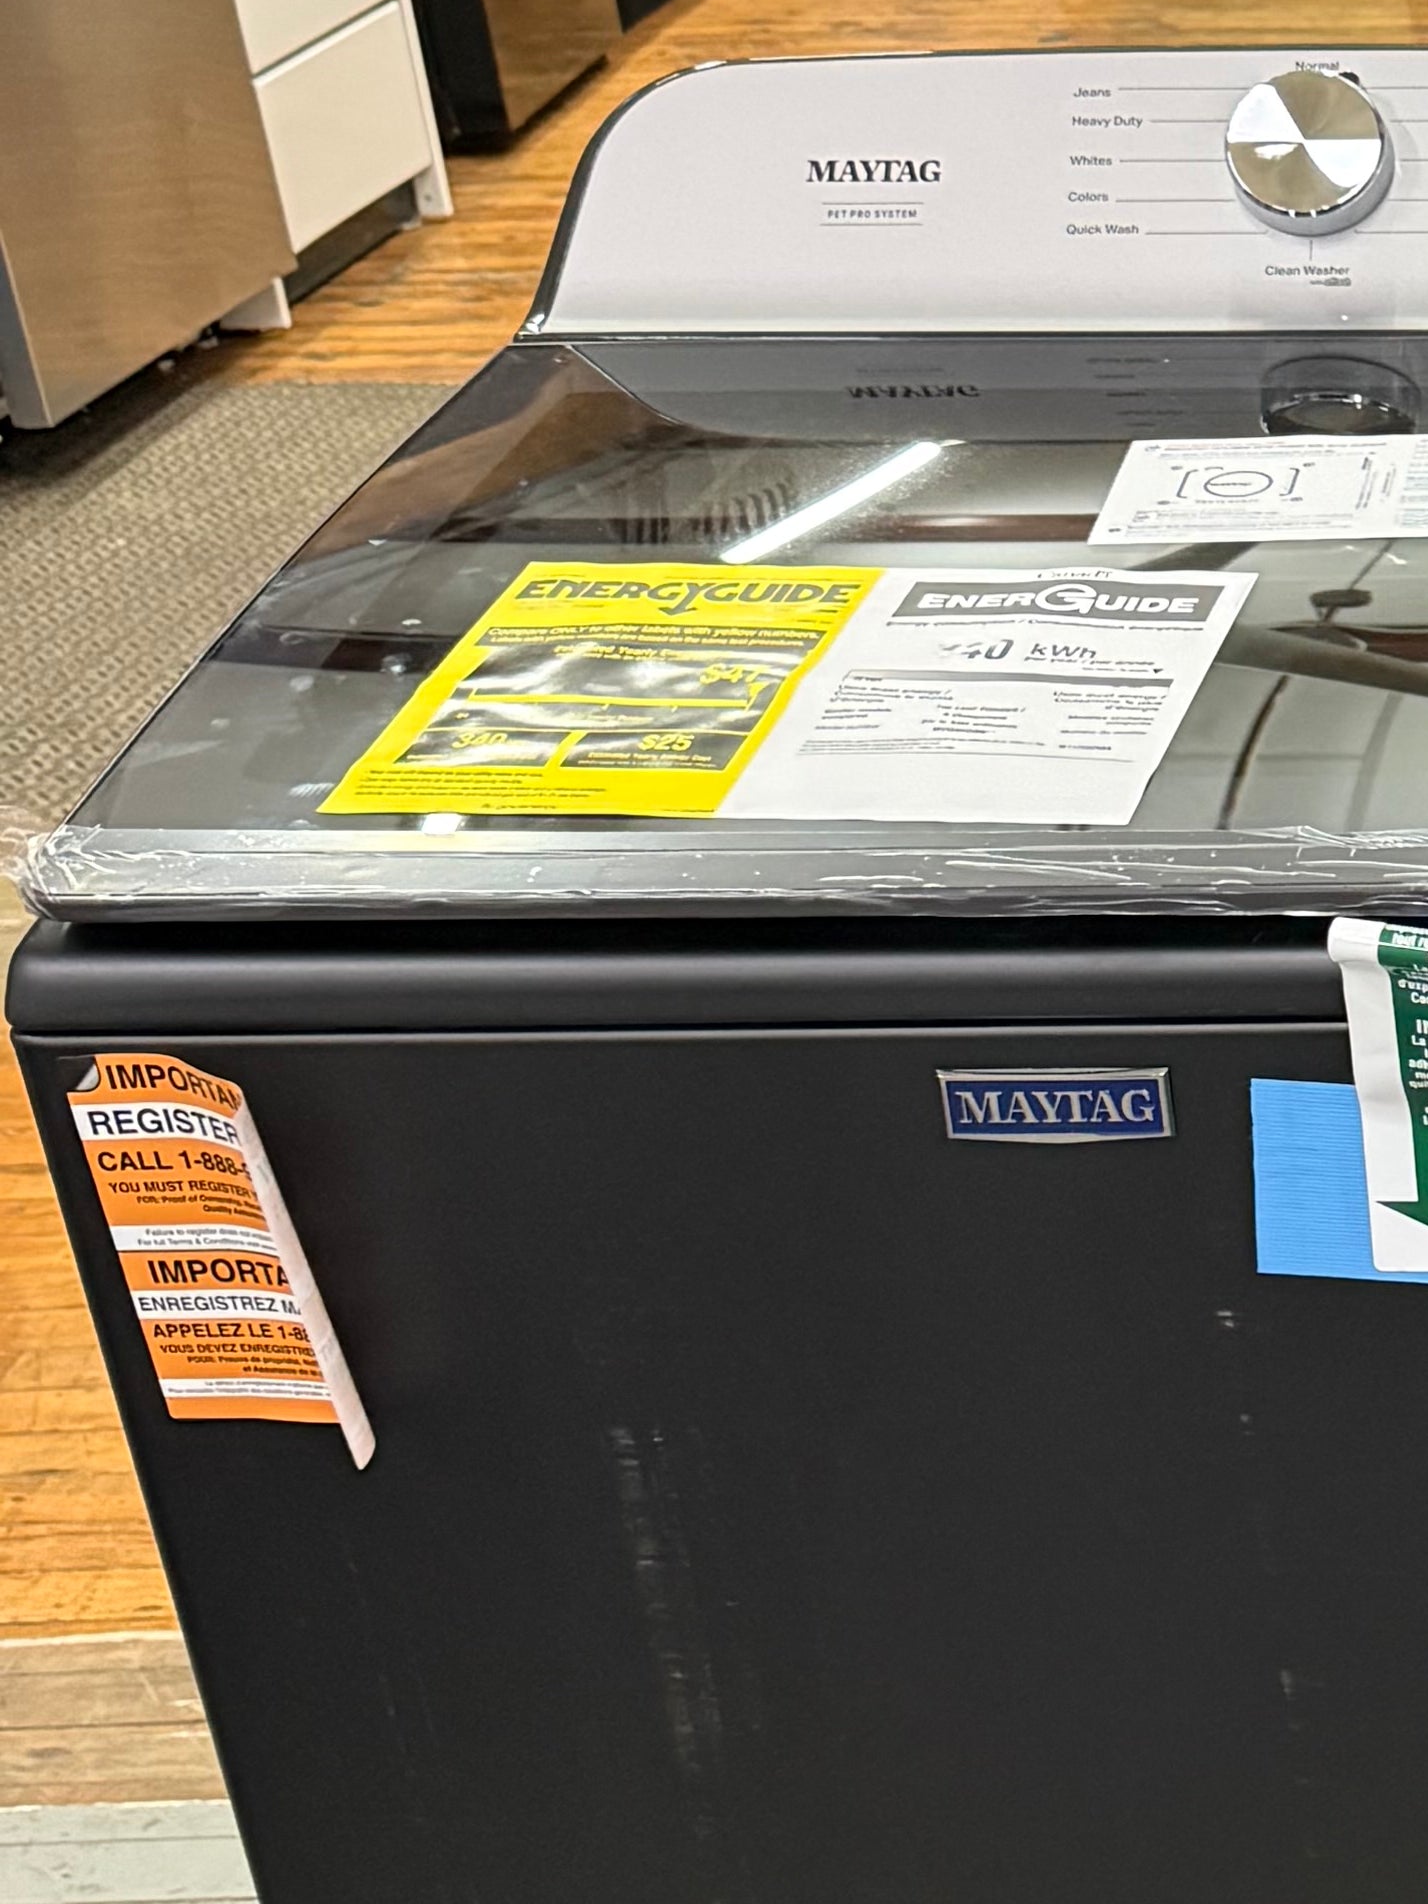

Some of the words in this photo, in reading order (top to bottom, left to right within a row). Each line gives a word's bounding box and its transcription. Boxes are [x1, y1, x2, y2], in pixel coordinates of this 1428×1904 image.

[1073, 88, 1111, 99] Jeans
[1072, 116, 1111, 129] Heavy
[1114, 116, 1143, 129] Duty
[1070, 155, 1113, 167] Whites
[806, 159, 942, 184] MAYTAG
[1067, 192, 1110, 203] Colors
[827, 209, 846, 219] PET
[848, 209, 872, 219] PRO
[874, 208, 918, 219] SYSTEM
[1066, 223, 1104, 236] Quick
[1107, 223, 1140, 235] Wash
[1264, 265, 1301, 277] Clean
[1303, 265, 1350, 277] Washer
[514, 578, 862, 611] ENERGYGUIDE
[916, 583, 1200, 615] ENERGUIDE
[1030, 642, 1096, 660] kWh
[638, 733, 696, 752] $25
[1411, 1035, 1426, 1046] La
[954, 1088, 1155, 1124] MAYTAG
[87, 1109, 238, 1145] REGISTER
[97, 1151, 173, 1171] CALL
[108, 1182, 140, 1194] YOU
[144, 1180, 185, 1192] MUST
[189, 1180, 250, 1197] REGISTER
[147, 1258, 289, 1286] IMPORTA
[138, 1295, 278, 1312] ENREGISTREZ
[153, 1323, 245, 1338] APPELEZ
[250, 1323, 274, 1338] LE
[160, 1344, 195, 1354] VOUS
[197, 1343, 237, 1354] DEVEZ
